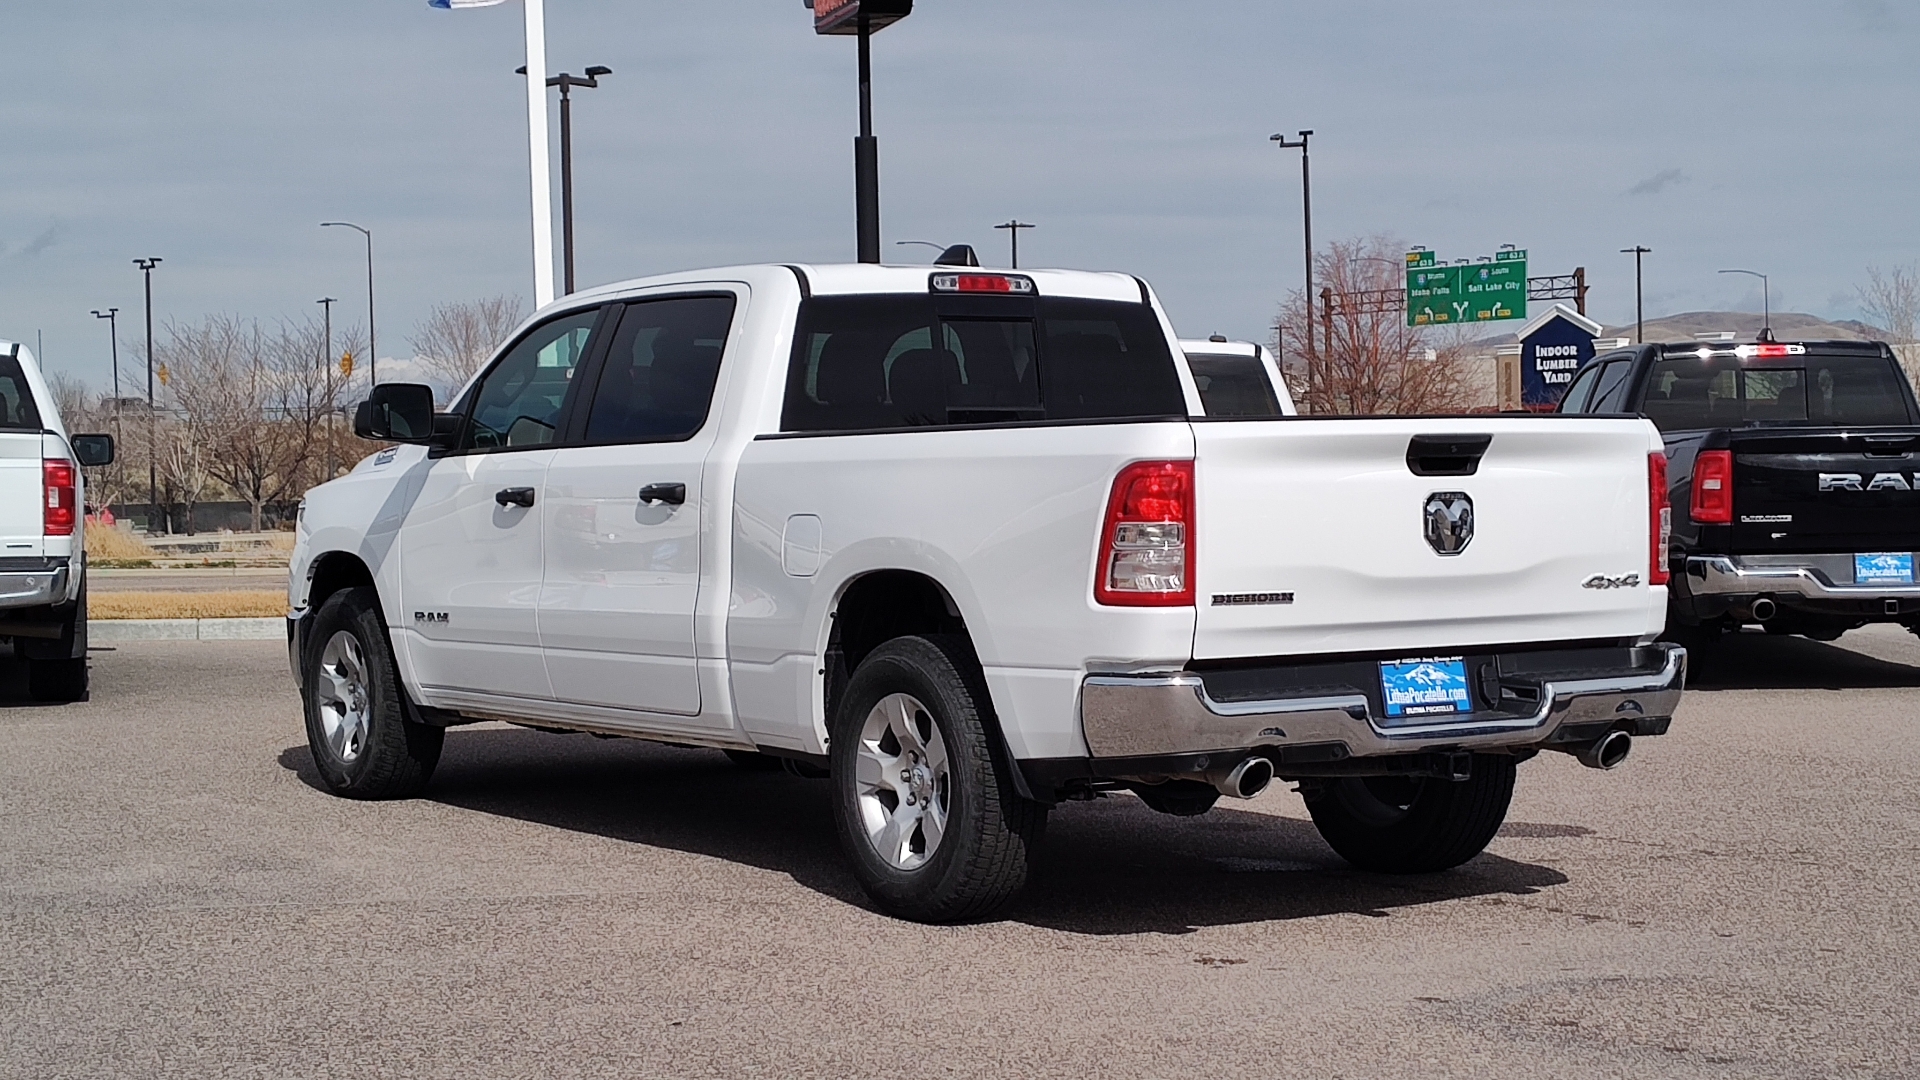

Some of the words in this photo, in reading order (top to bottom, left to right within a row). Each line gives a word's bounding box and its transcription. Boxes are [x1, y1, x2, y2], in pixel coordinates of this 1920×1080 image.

[1411, 288, 1431, 297] Idaho
[1468, 284, 1483, 293] Salt
[1485, 283, 1503, 292] Lake
[1505, 281, 1521, 291] City
[1535, 344, 1578, 358] INDOOR
[1536, 358, 1578, 371] LUMBER
[1542, 371, 1572, 384] YARD
[1818, 472, 1920, 492] RA
[414, 611, 449, 623] RAM
